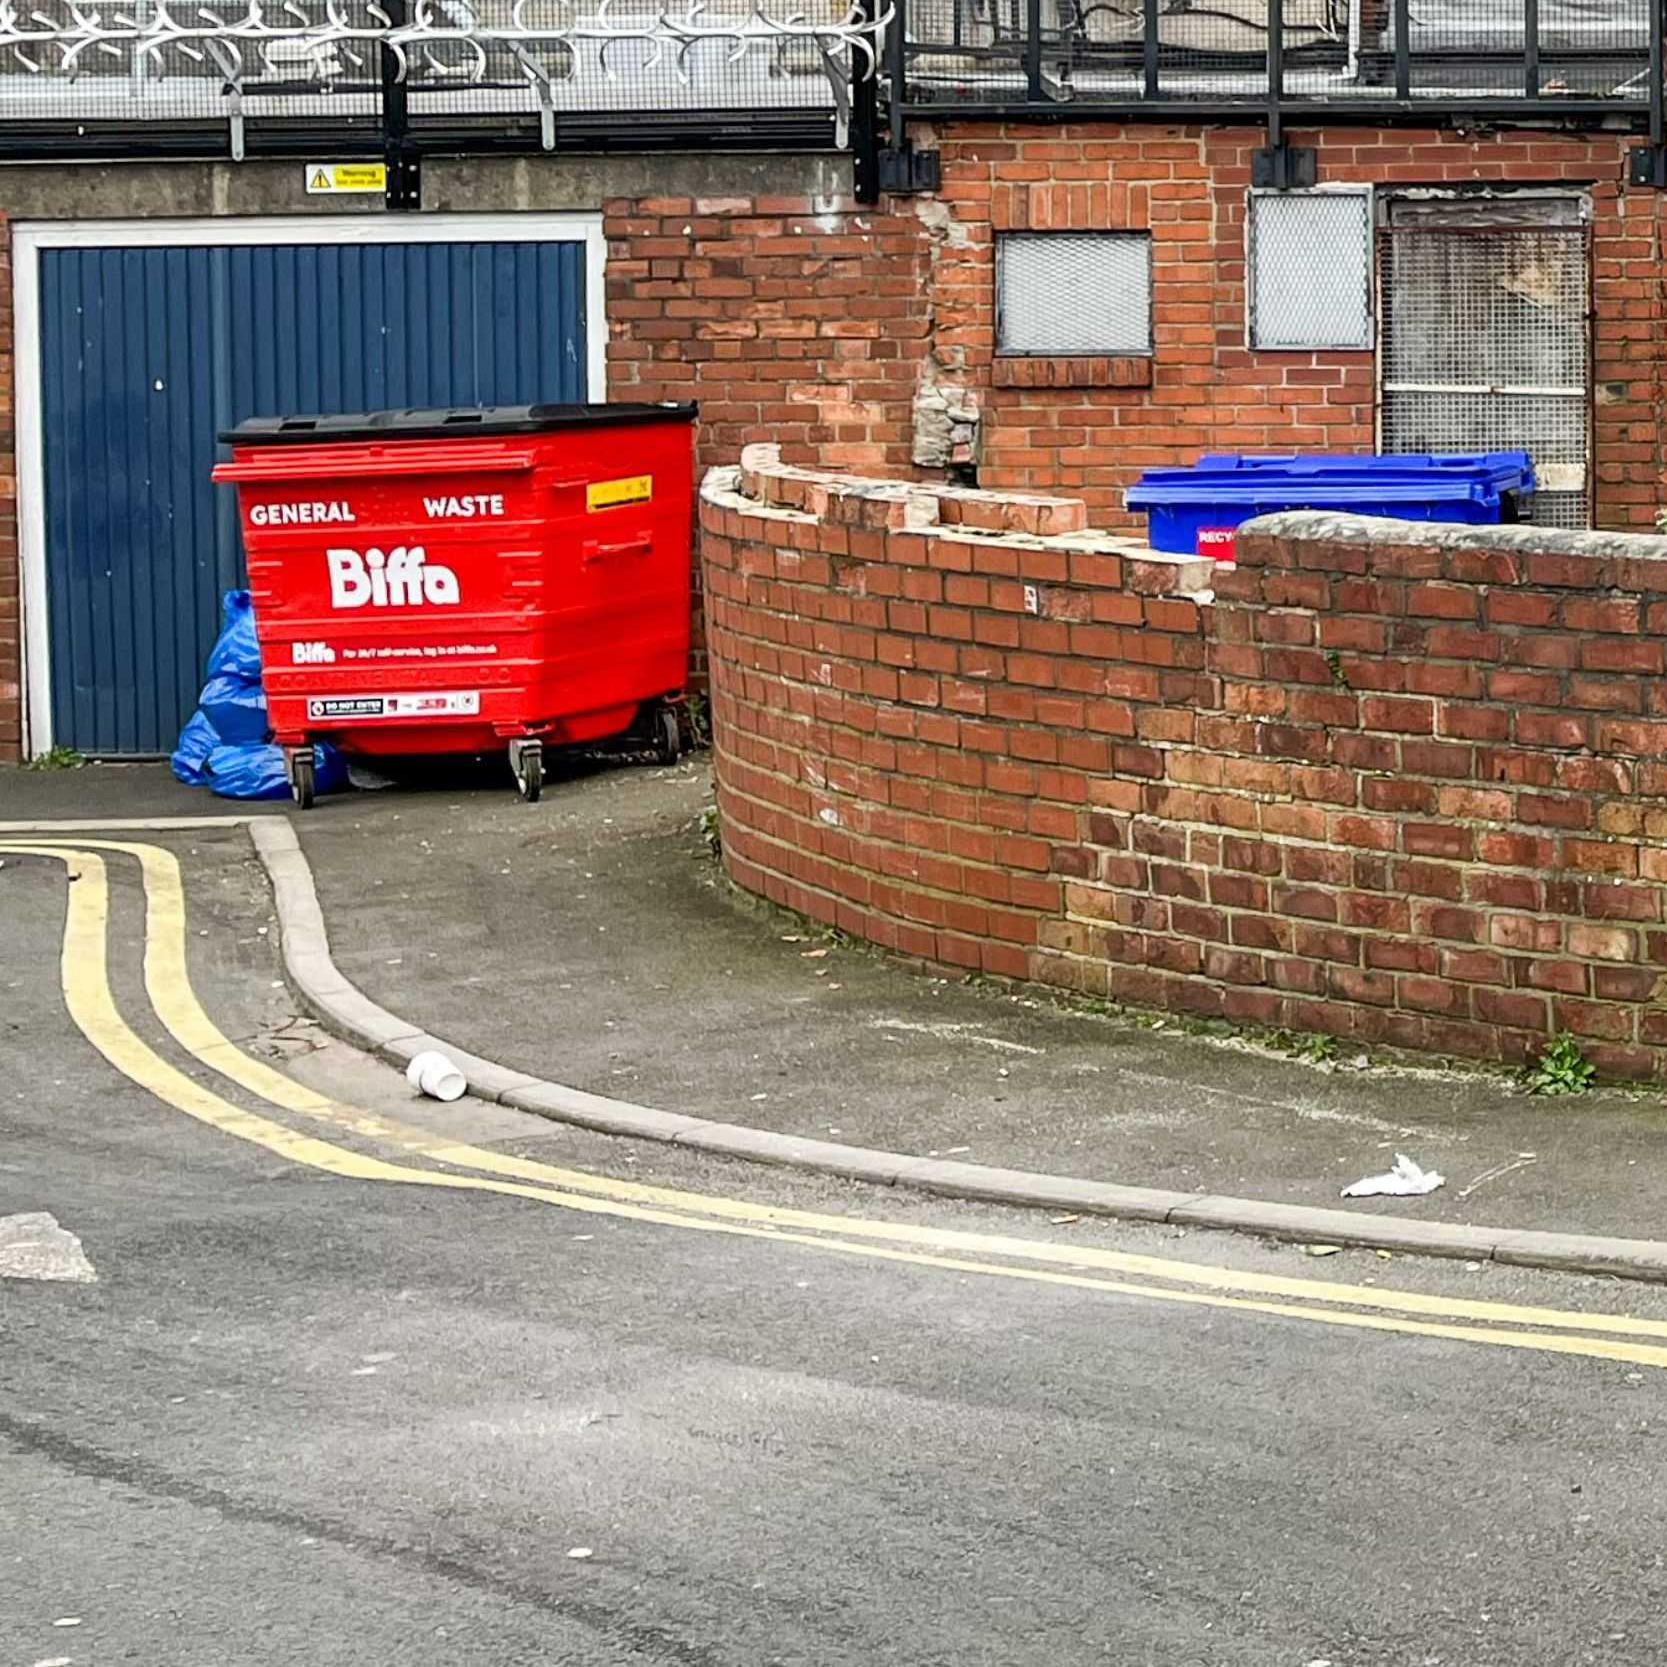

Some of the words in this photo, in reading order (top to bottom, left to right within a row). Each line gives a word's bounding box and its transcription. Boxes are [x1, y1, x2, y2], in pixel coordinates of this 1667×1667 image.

[250, 502, 356, 525] GENERAL
[423, 494, 504, 518] WASTE
[1199, 531, 1236, 544] RECY
[326, 546, 461, 609] Biffa
[292, 641, 336, 664] Biffa
